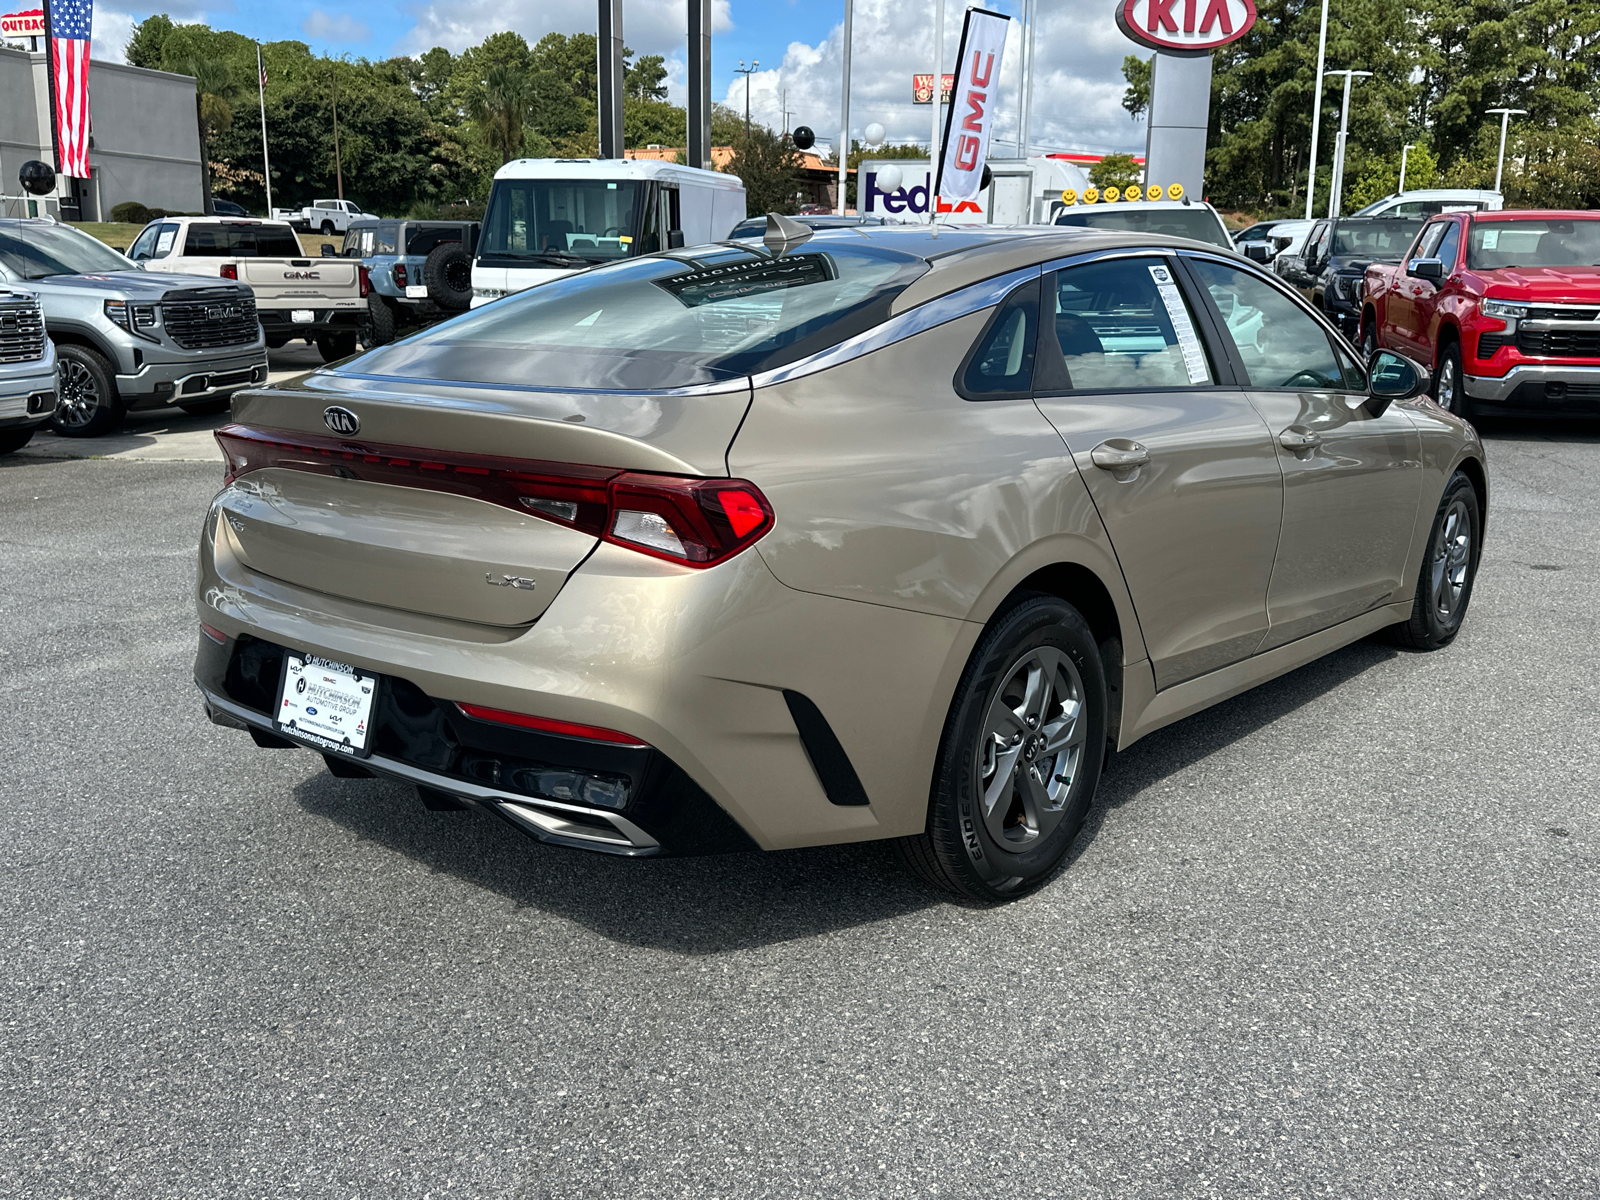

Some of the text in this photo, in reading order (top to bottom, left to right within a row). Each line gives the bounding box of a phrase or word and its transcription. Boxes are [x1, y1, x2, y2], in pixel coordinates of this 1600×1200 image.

[2, 19, 44, 31] OUTBAC
[1147, 0, 1233, 34] KIA
[954, 50, 995, 172] GMC
[283, 271, 320, 280] GMC
[325, 412, 354, 431] KIA
[312, 656, 354, 674] HUTCHINSON
[323, 676, 337, 684] GMC
[306, 695, 339, 711] AUTOMOTIVE
[338, 705, 357, 716] GROUP
[307, 682, 362, 709] HUTCHINSON
[280, 723, 355, 755] Hutchinsonautogroup.com
[1026, 738, 1039, 759] KIA
[956, 732, 982, 862] ENDEAVOR
